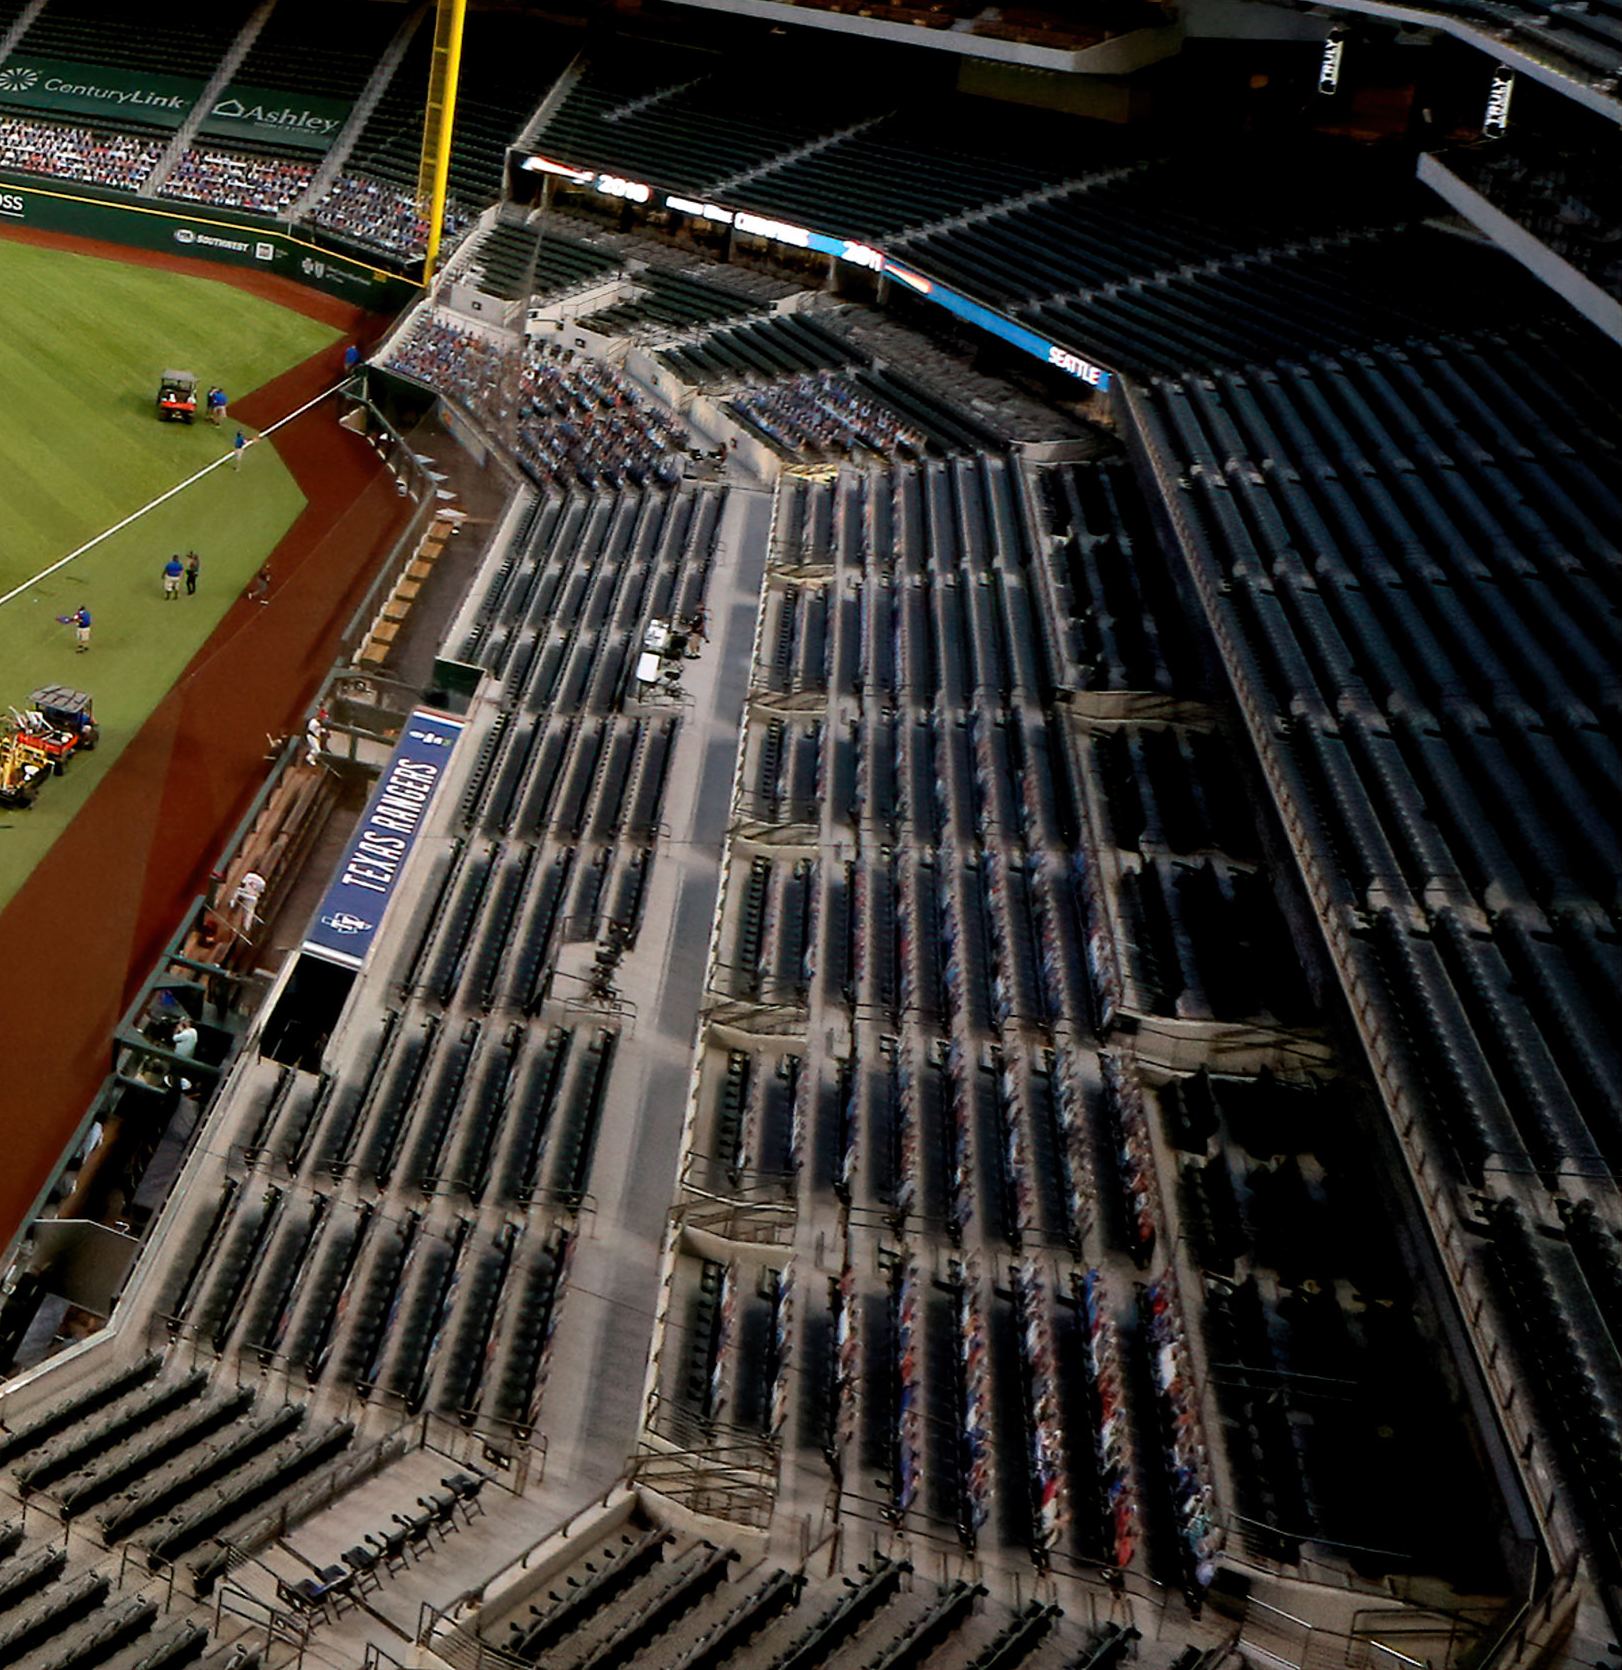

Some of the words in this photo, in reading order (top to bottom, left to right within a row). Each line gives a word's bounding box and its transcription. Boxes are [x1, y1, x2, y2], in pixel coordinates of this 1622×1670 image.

[44, 77, 186, 111] CenturyLink
[242, 104, 342, 135] Ashley
[1047, 345, 1102, 387] SEATTLE
[370, 757, 439, 835] RANGERS
[341, 830, 409, 894] TEXAS
